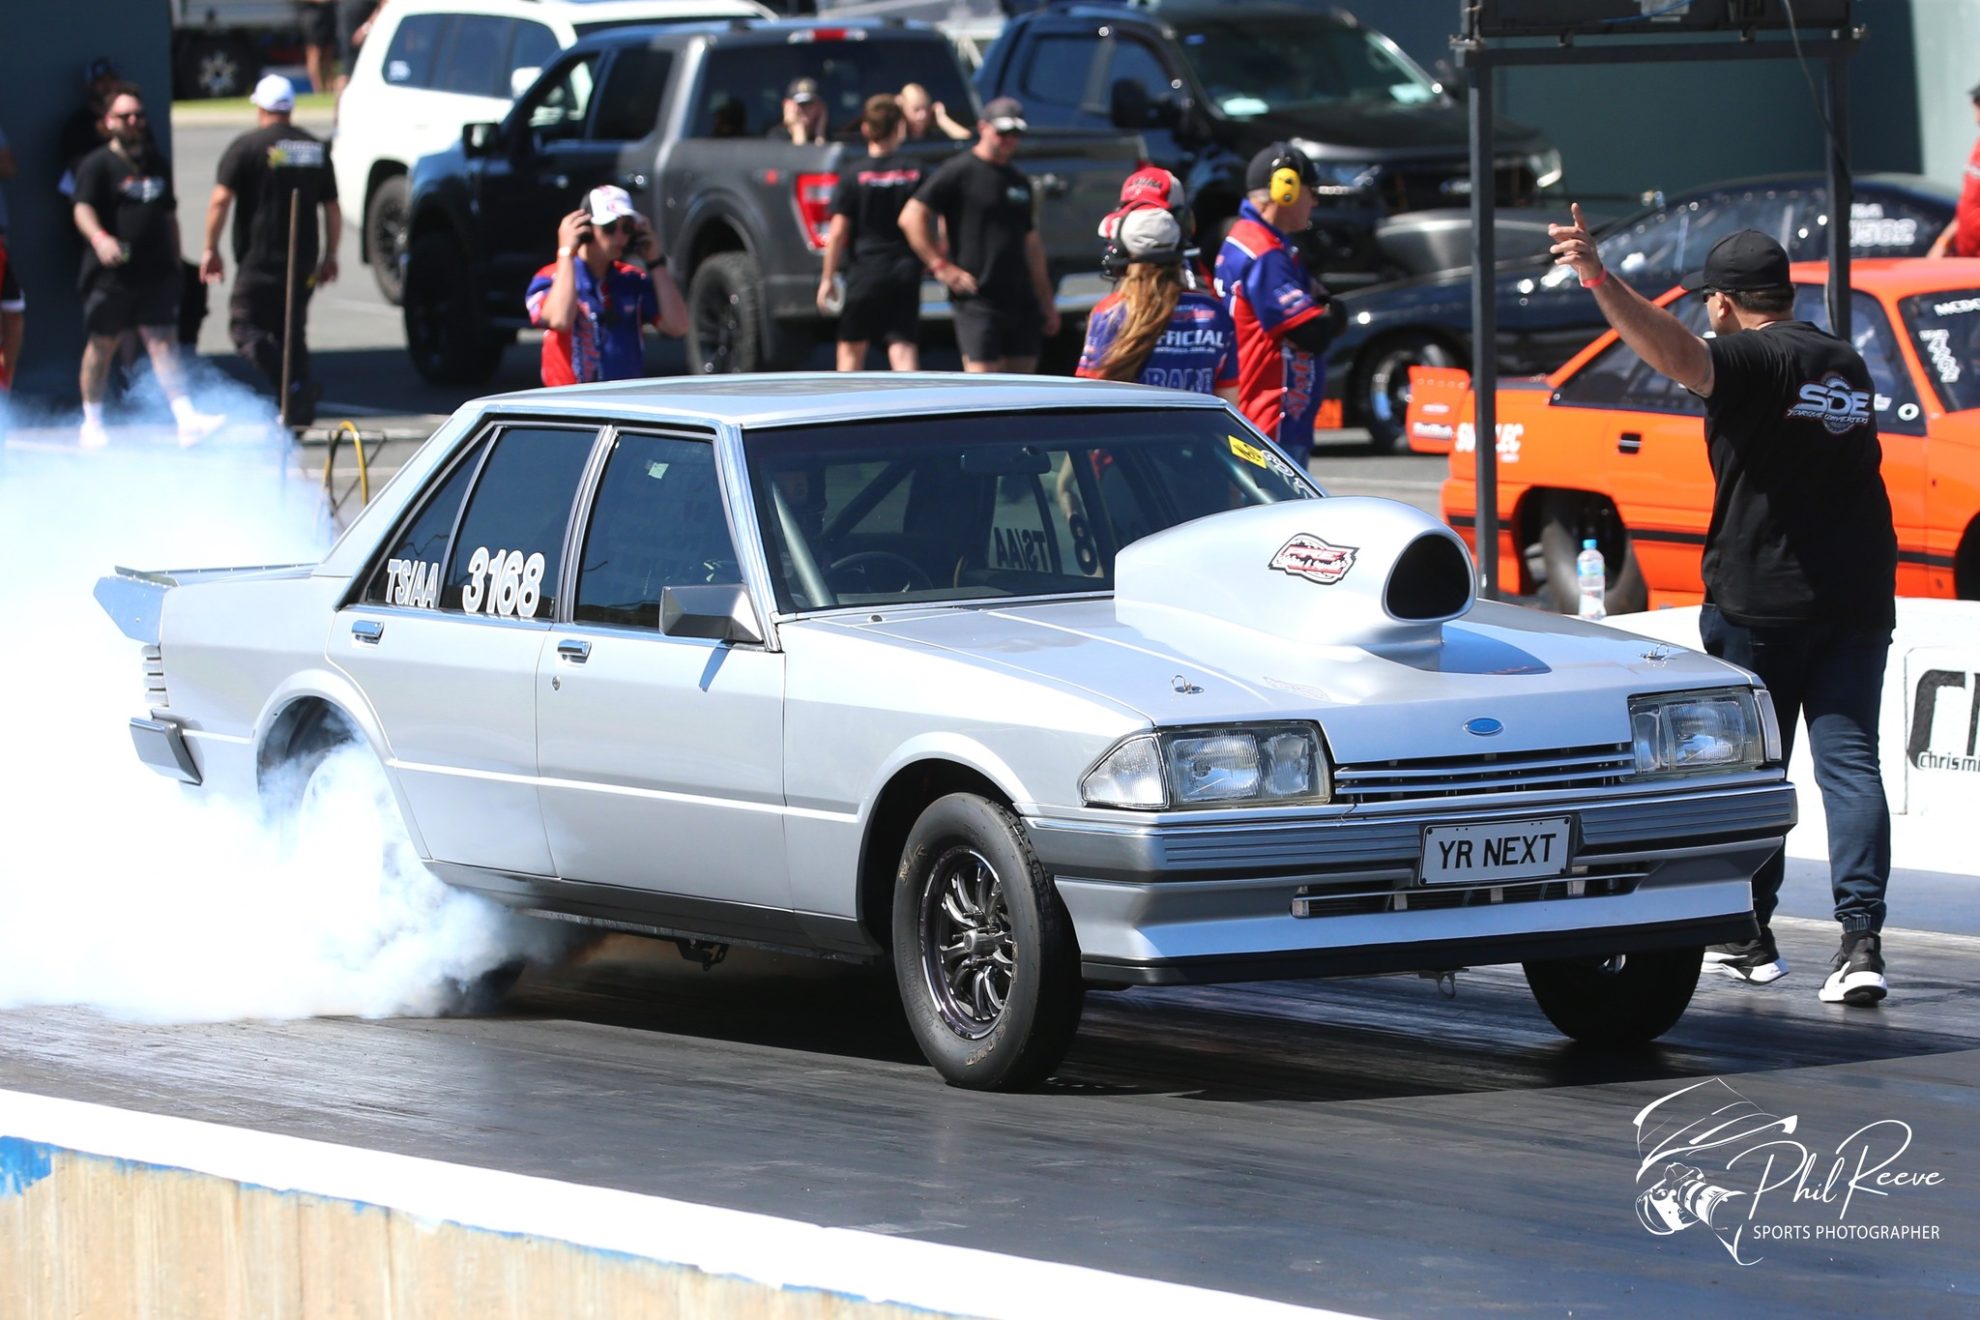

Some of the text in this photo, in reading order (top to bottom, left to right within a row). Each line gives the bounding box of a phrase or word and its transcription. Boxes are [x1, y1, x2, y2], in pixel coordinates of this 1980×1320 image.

[1793, 383, 1871, 417] SDE
[385, 546, 545, 618] TS/AA 3168
[1438, 833, 1557, 870] YR NEXT
